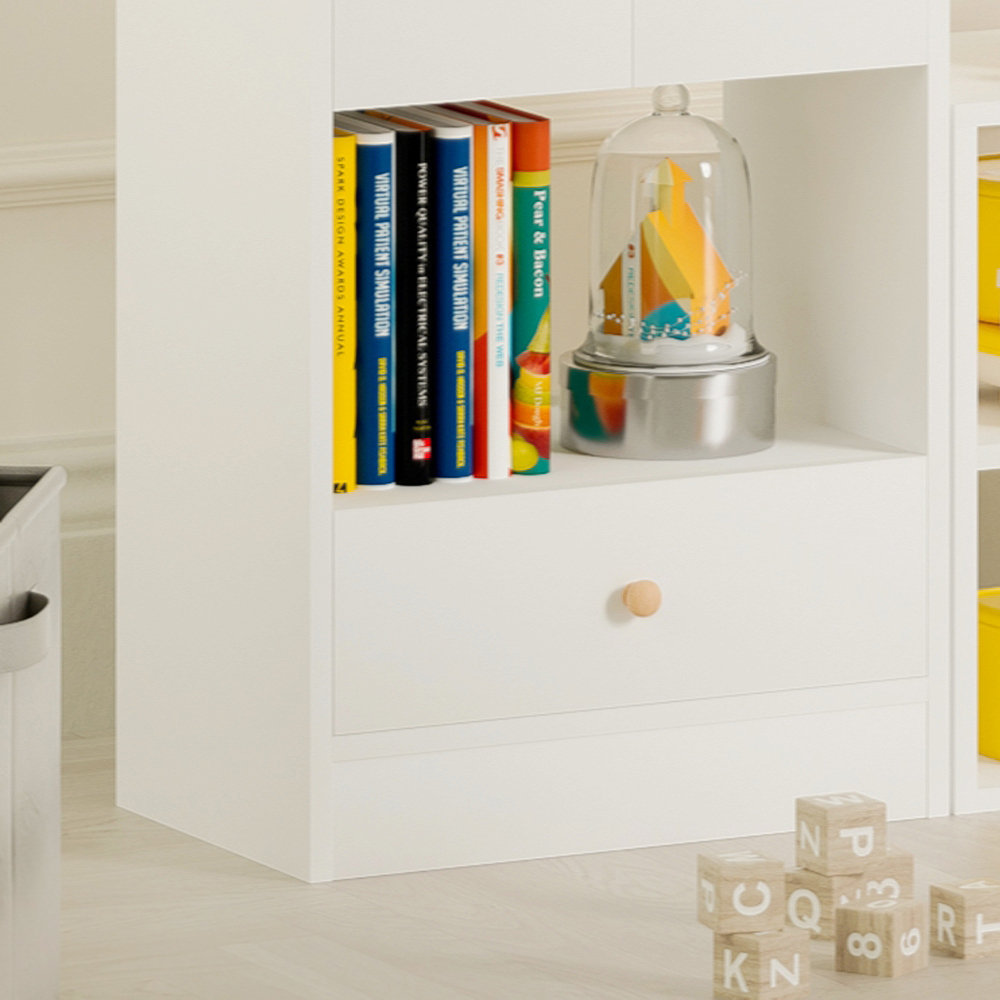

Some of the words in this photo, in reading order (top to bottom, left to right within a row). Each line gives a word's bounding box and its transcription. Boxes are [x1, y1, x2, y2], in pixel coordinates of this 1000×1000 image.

[336, 156, 346, 192] SPARK
[374, 172, 391, 220] VIRTUAL
[417, 162, 428, 205] POWER
[452, 166, 469, 214] VIRTUAL
[495, 167, 505, 220] SMASHING
[336, 198, 346, 245] DESIGN
[532, 189, 547, 227] Pear
[374, 221, 391, 267] PATIENT
[415, 207, 428, 262] QUALITY
[452, 215, 469, 260] PATIENT
[532, 230, 547, 244] &
[336, 250, 346, 301] AWARDS
[452, 262, 469, 330] SIMULATION
[532, 248, 547, 298] Bacon
[374, 268, 391, 337] SIMULATION
[417, 276, 428, 351] ELECTRICAL
[336, 306, 345, 357] ANNUAL
[495, 323, 505, 342] THE
[495, 345, 505, 368] WEB
[417, 352, 428, 408] SYSTEMS
[800, 820, 821, 858] N
[838, 826, 874, 857] P
[732, 881, 771, 916] C
[787, 888, 822, 934] Q
[865, 877, 900, 899] 3
[846, 932, 882, 960] 8
[937, 902, 958, 947] R
[722, 948, 750, 994] K
[769, 952, 800, 989] N
